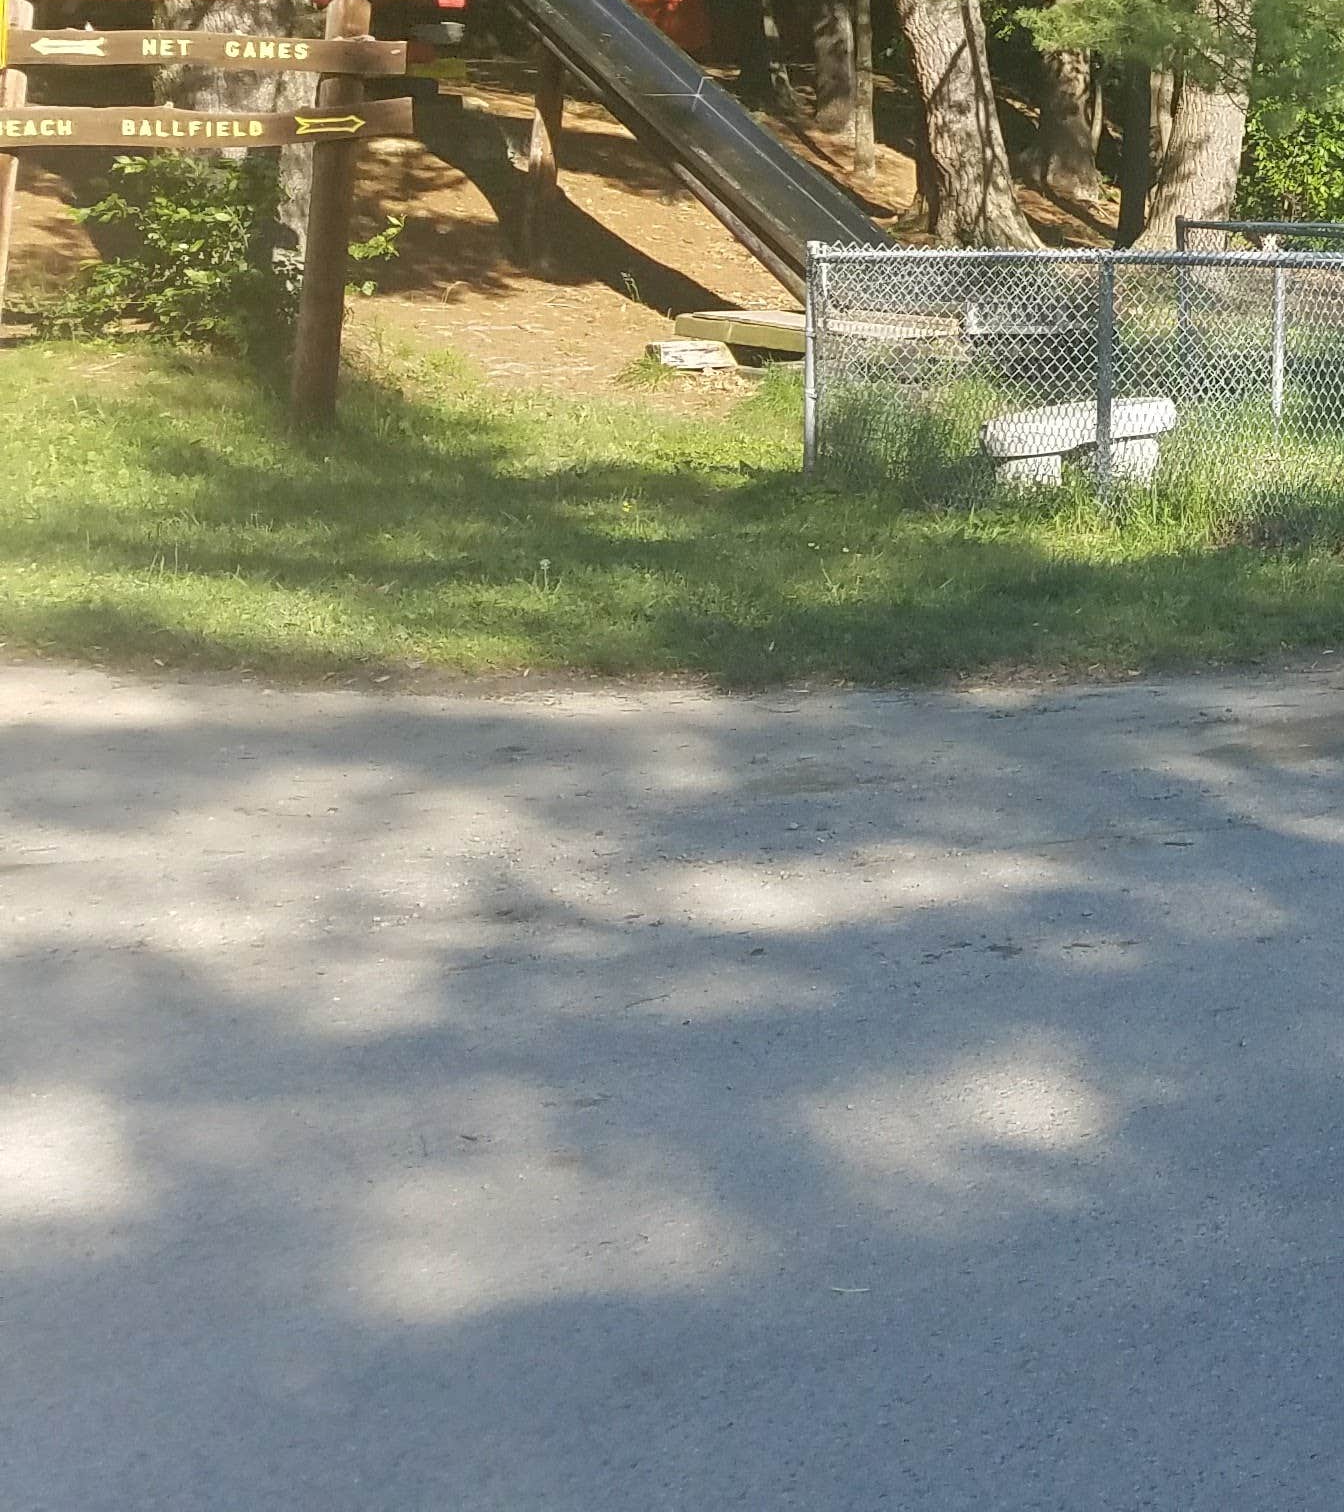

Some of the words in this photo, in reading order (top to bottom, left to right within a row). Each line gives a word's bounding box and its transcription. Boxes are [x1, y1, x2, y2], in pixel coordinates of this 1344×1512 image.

[142, 39, 194, 56] NET
[224, 41, 309, 60] GAMES
[0, 119, 73, 137] EACH
[121, 119, 264, 138] BALLFIELD
